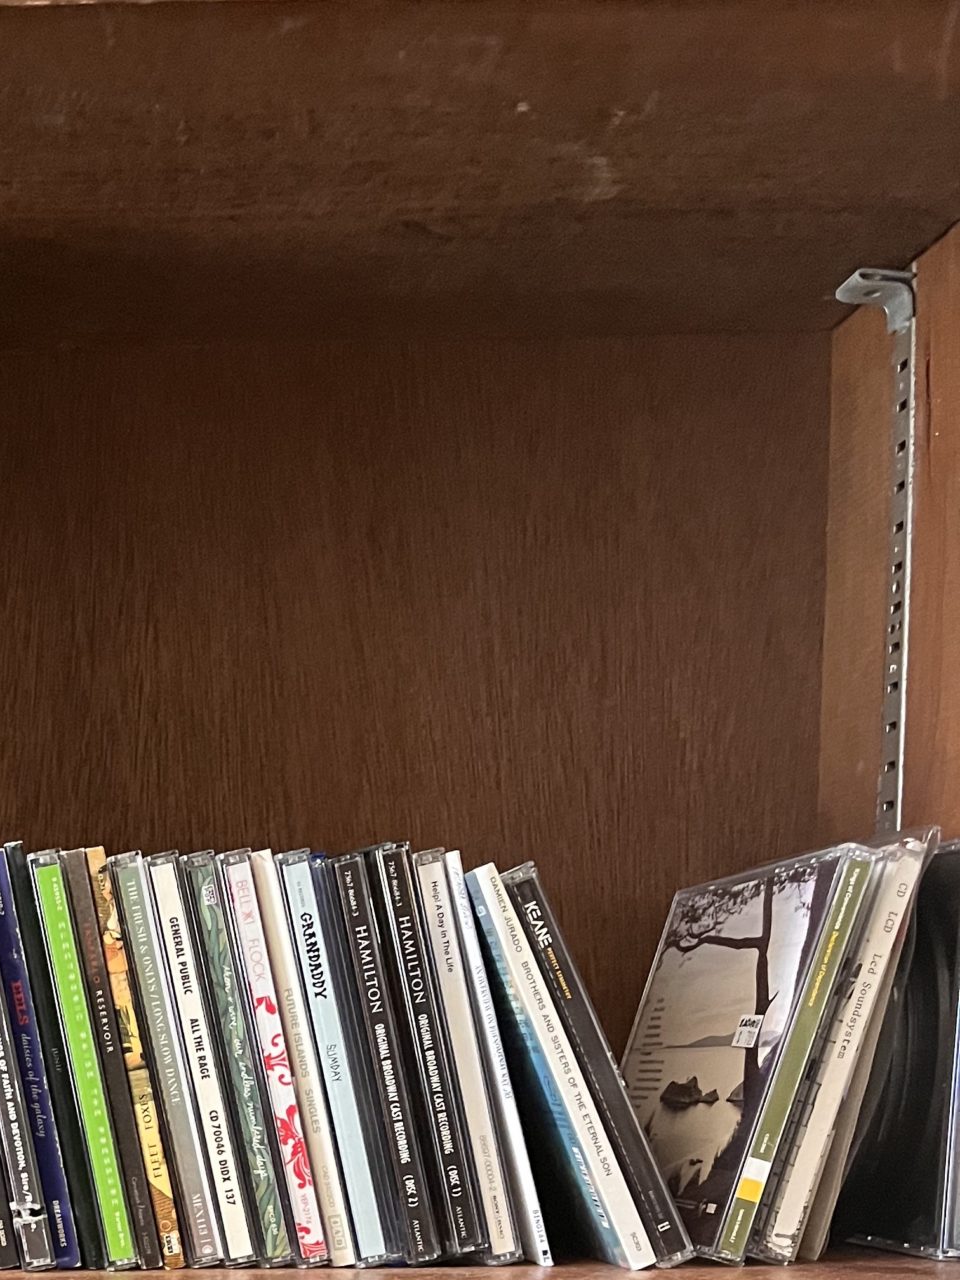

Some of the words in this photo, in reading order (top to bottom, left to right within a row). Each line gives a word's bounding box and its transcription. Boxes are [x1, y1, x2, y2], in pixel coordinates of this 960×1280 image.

[126, 879, 139, 901] THE
[131, 905, 147, 942] FRESH
[169, 917, 185, 959] GENERAL
[139, 944, 148, 954] &
[142, 956, 157, 992] ONLYS
[177, 961, 192, 995] PUBLIC
[150, 1000, 165, 1031] LONG
[190, 1018, 201, 1034] ALL
[490, 877, 507, 913] DAMIEN
[504, 915, 523, 953] JURADO
[521, 961, 546, 1010] BROTHERS
[542, 1014, 555, 1033] AND
[551, 1035, 573, 1074] SISTERS
[567, 1077, 576, 1089] OF
[574, 1092, 586, 1111] THE
[582, 1113, 602, 1156] ETERNAL
[600, 1158, 612, 1177] SON
[158, 1034, 171, 1065] SLOW
[193, 1035, 204, 1054] THE
[196, 1056, 211, 1080] RAGE
[283, 988, 300, 1029] FUTURE
[292, 1033, 310, 1078] ISLANDS
[304, 1089, 319, 1133] SINGLES
[165, 1068, 181, 1105] DANCE
[209, 1109, 219, 1122] CD
[212, 1124, 226, 1156] 70046
[218, 1160, 231, 1183] DIDX
[224, 1189, 236, 1206] 137
